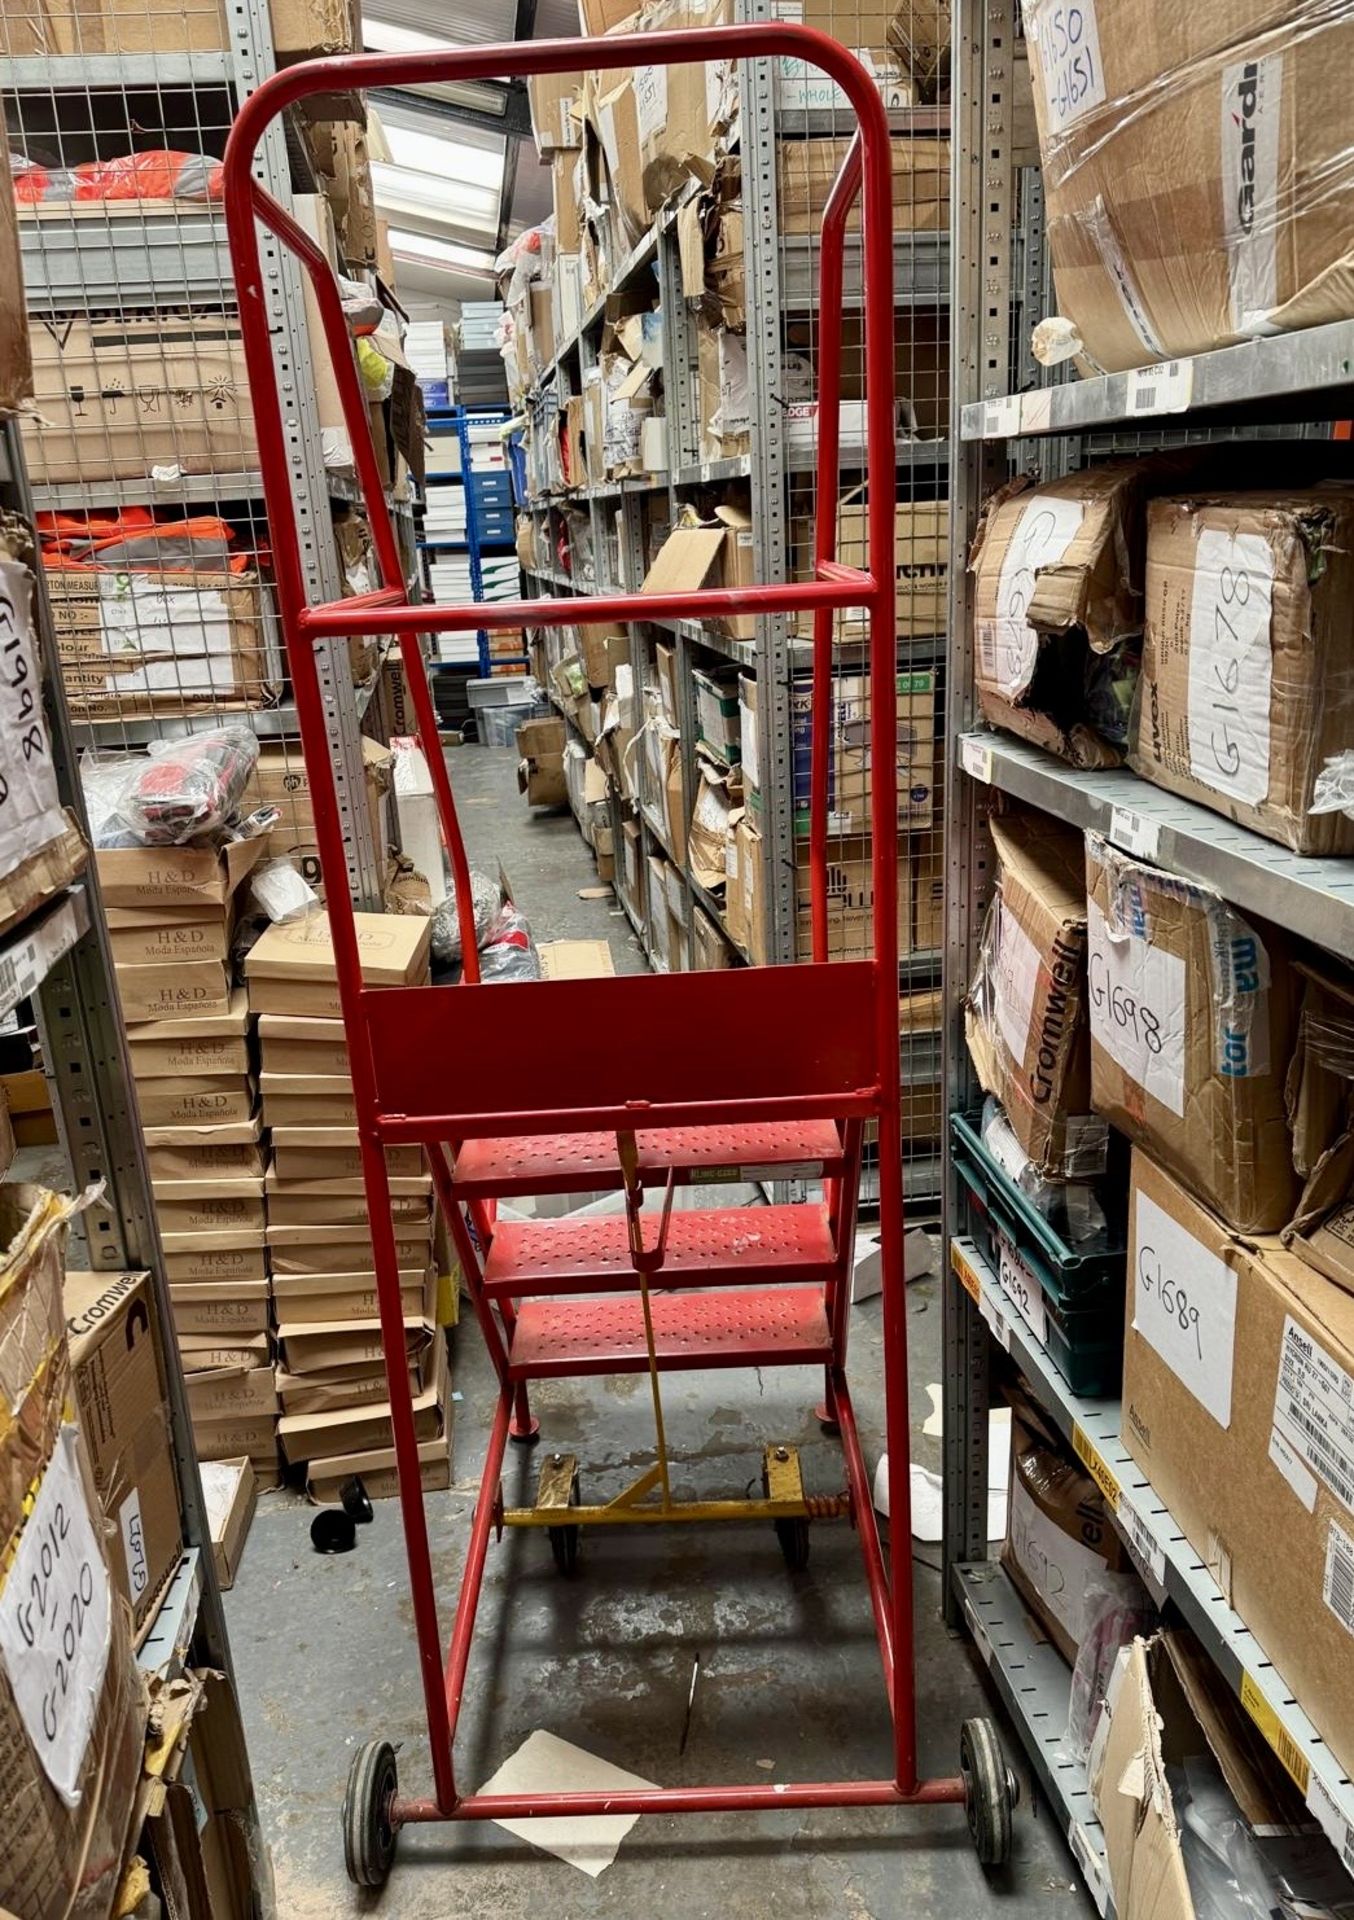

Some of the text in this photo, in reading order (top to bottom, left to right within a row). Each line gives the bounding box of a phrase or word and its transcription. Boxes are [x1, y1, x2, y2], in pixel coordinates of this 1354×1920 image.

[386, 664, 406, 735] Cromwell
[1210, 566, 1250, 776] G1678
[1151, 682, 1162, 763] uvex
[1090, 952, 1162, 1053] G1698
[1001, 1262, 1031, 1315] G1692
[1139, 1245, 1202, 1361] G1689
[1288, 1326, 1313, 1358] Ansell
[1075, 1500, 1105, 1545] ell
[17, 1502, 71, 1648] G2012
[42, 1562, 93, 1741] G2020
